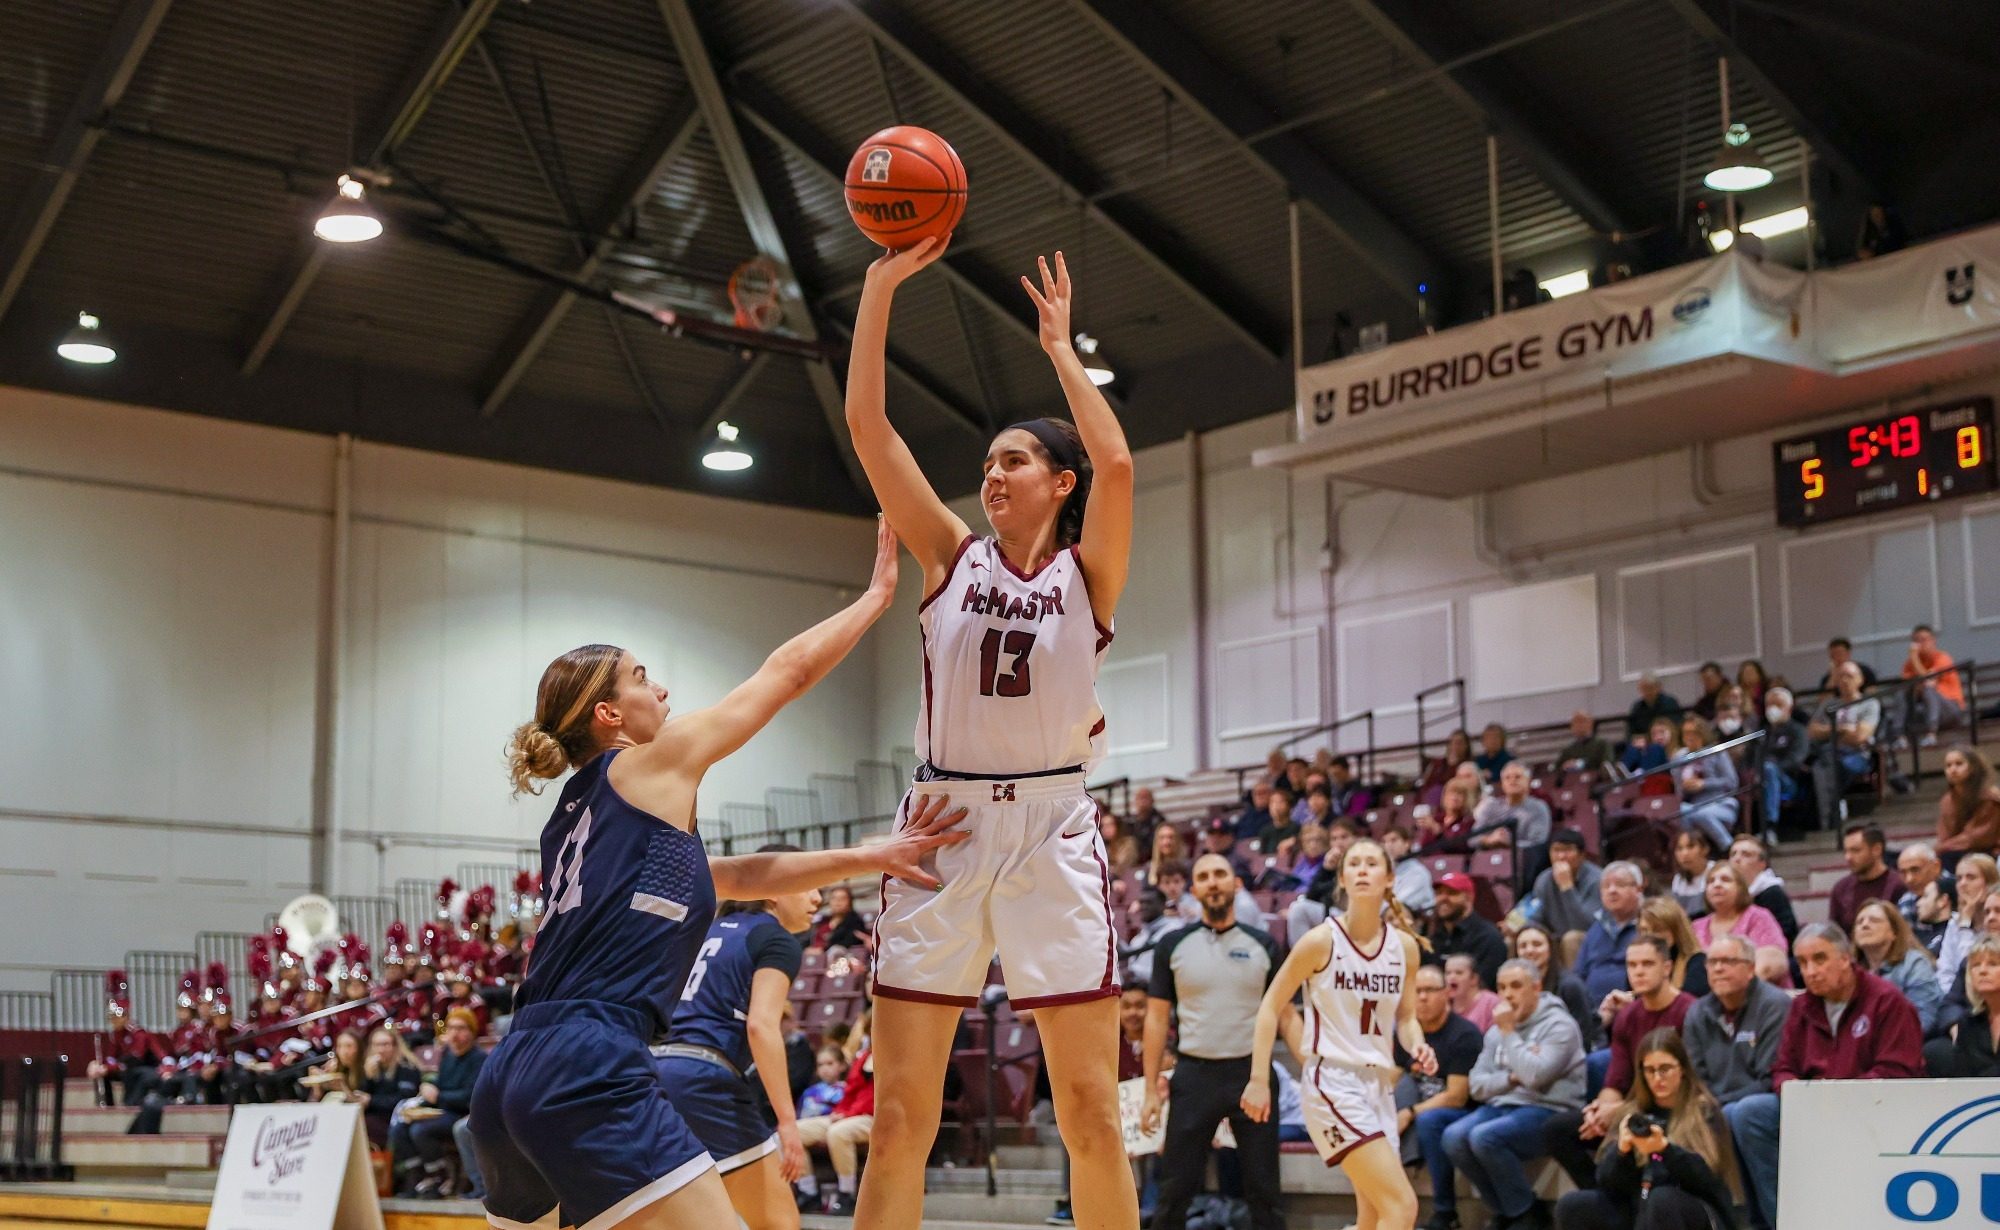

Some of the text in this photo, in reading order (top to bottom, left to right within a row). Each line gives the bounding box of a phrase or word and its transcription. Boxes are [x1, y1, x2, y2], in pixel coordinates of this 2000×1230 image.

[1348, 336, 1542, 415] BURRIDGE
[1557, 305, 1654, 359] GYM
[1848, 415, 1921, 468] 5:43
[1957, 425, 1981, 469] 8
[1801, 458, 1824, 500] 5
[1917, 468, 1927, 496] 1
[980, 627, 1037, 697] 13
[1335, 971, 1400, 994] McMASTER
[252, 1114, 319, 1168] Campus
[1885, 1171, 2000, 1224] O
